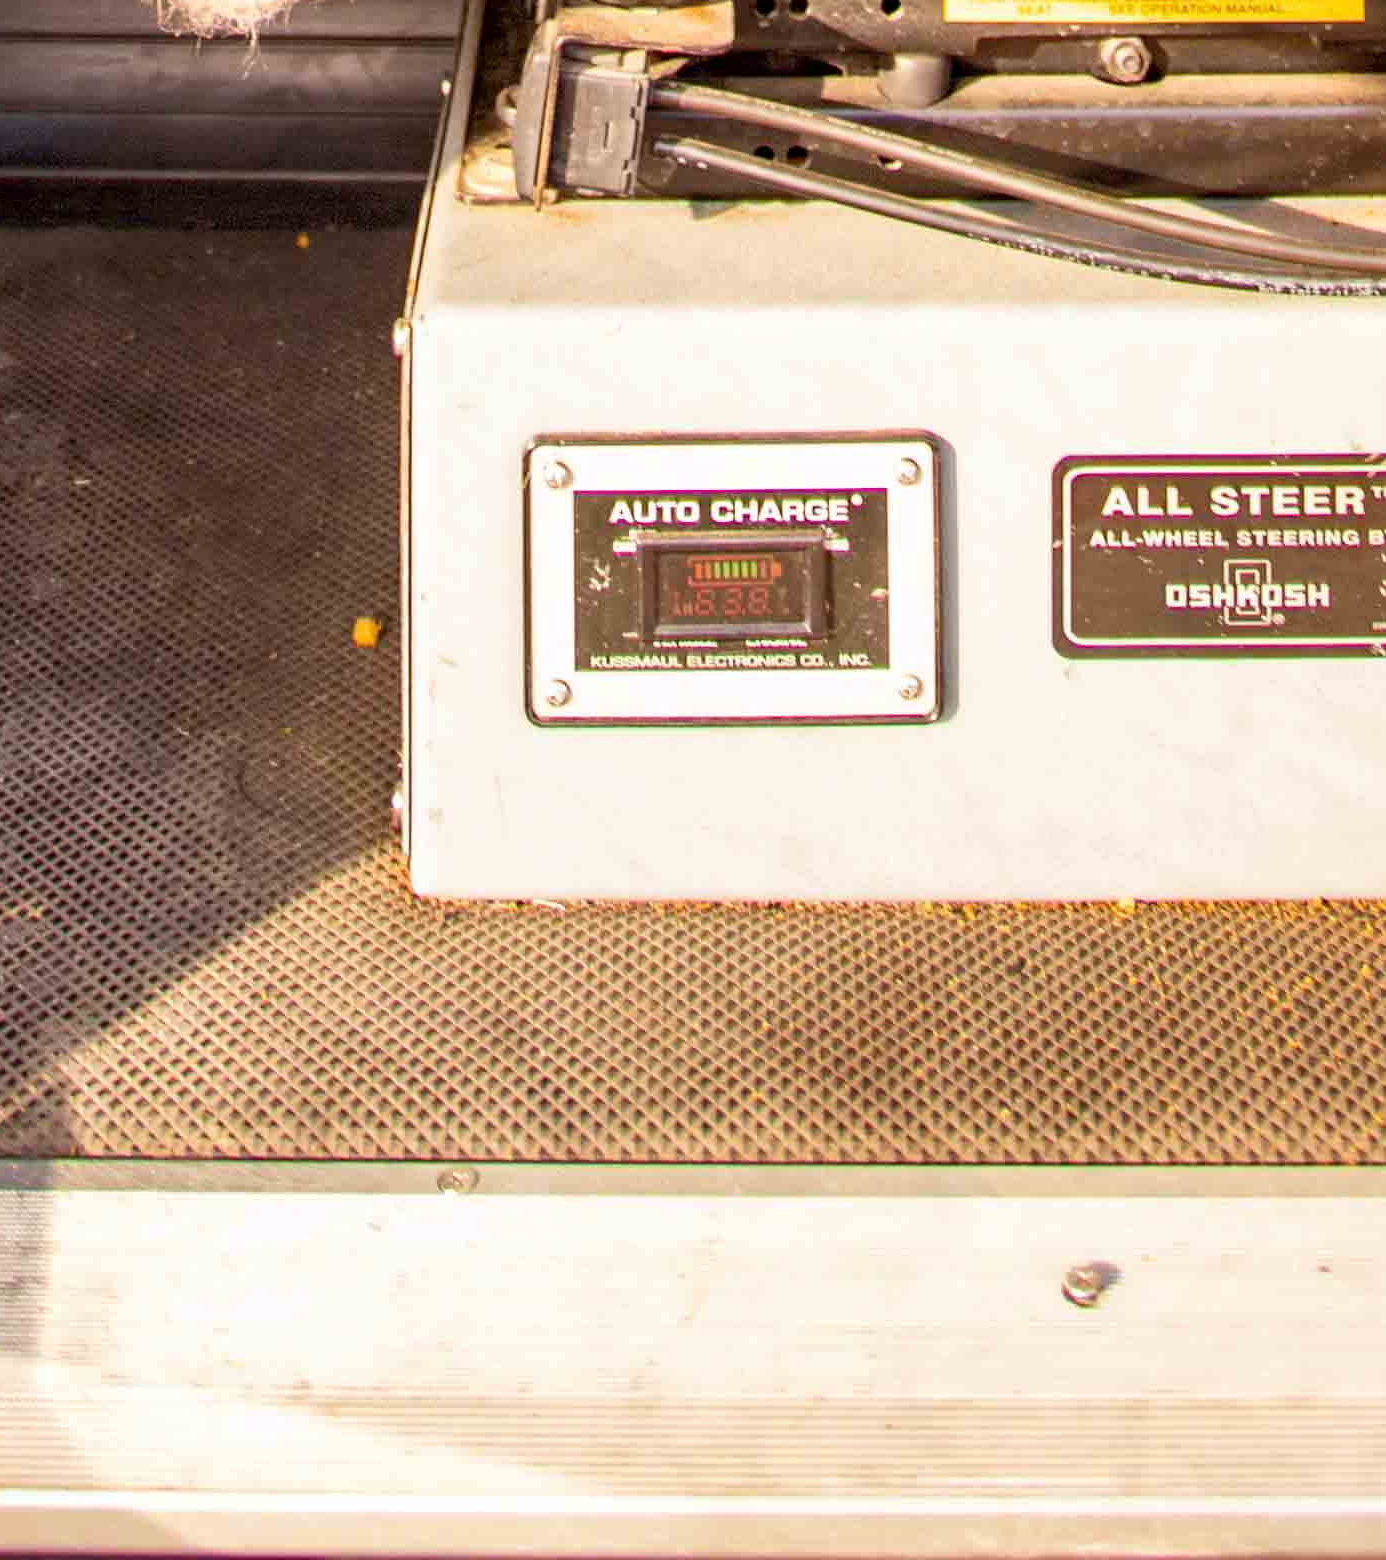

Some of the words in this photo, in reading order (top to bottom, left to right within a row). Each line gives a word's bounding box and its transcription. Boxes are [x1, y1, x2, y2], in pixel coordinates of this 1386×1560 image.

[610, 500, 700, 523] AUTO
[1103, 486, 1193, 516] ALL
[1089, 530, 1228, 547] ALL-WHEEL
[1237, 530, 1359, 547] STEERING
[1165, 583, 1331, 608] OSHKOSH
[590, 655, 682, 669] KUSSMAUL
[687, 655, 795, 669] ELECTRONICS
[839, 655, 871, 668] INC.
